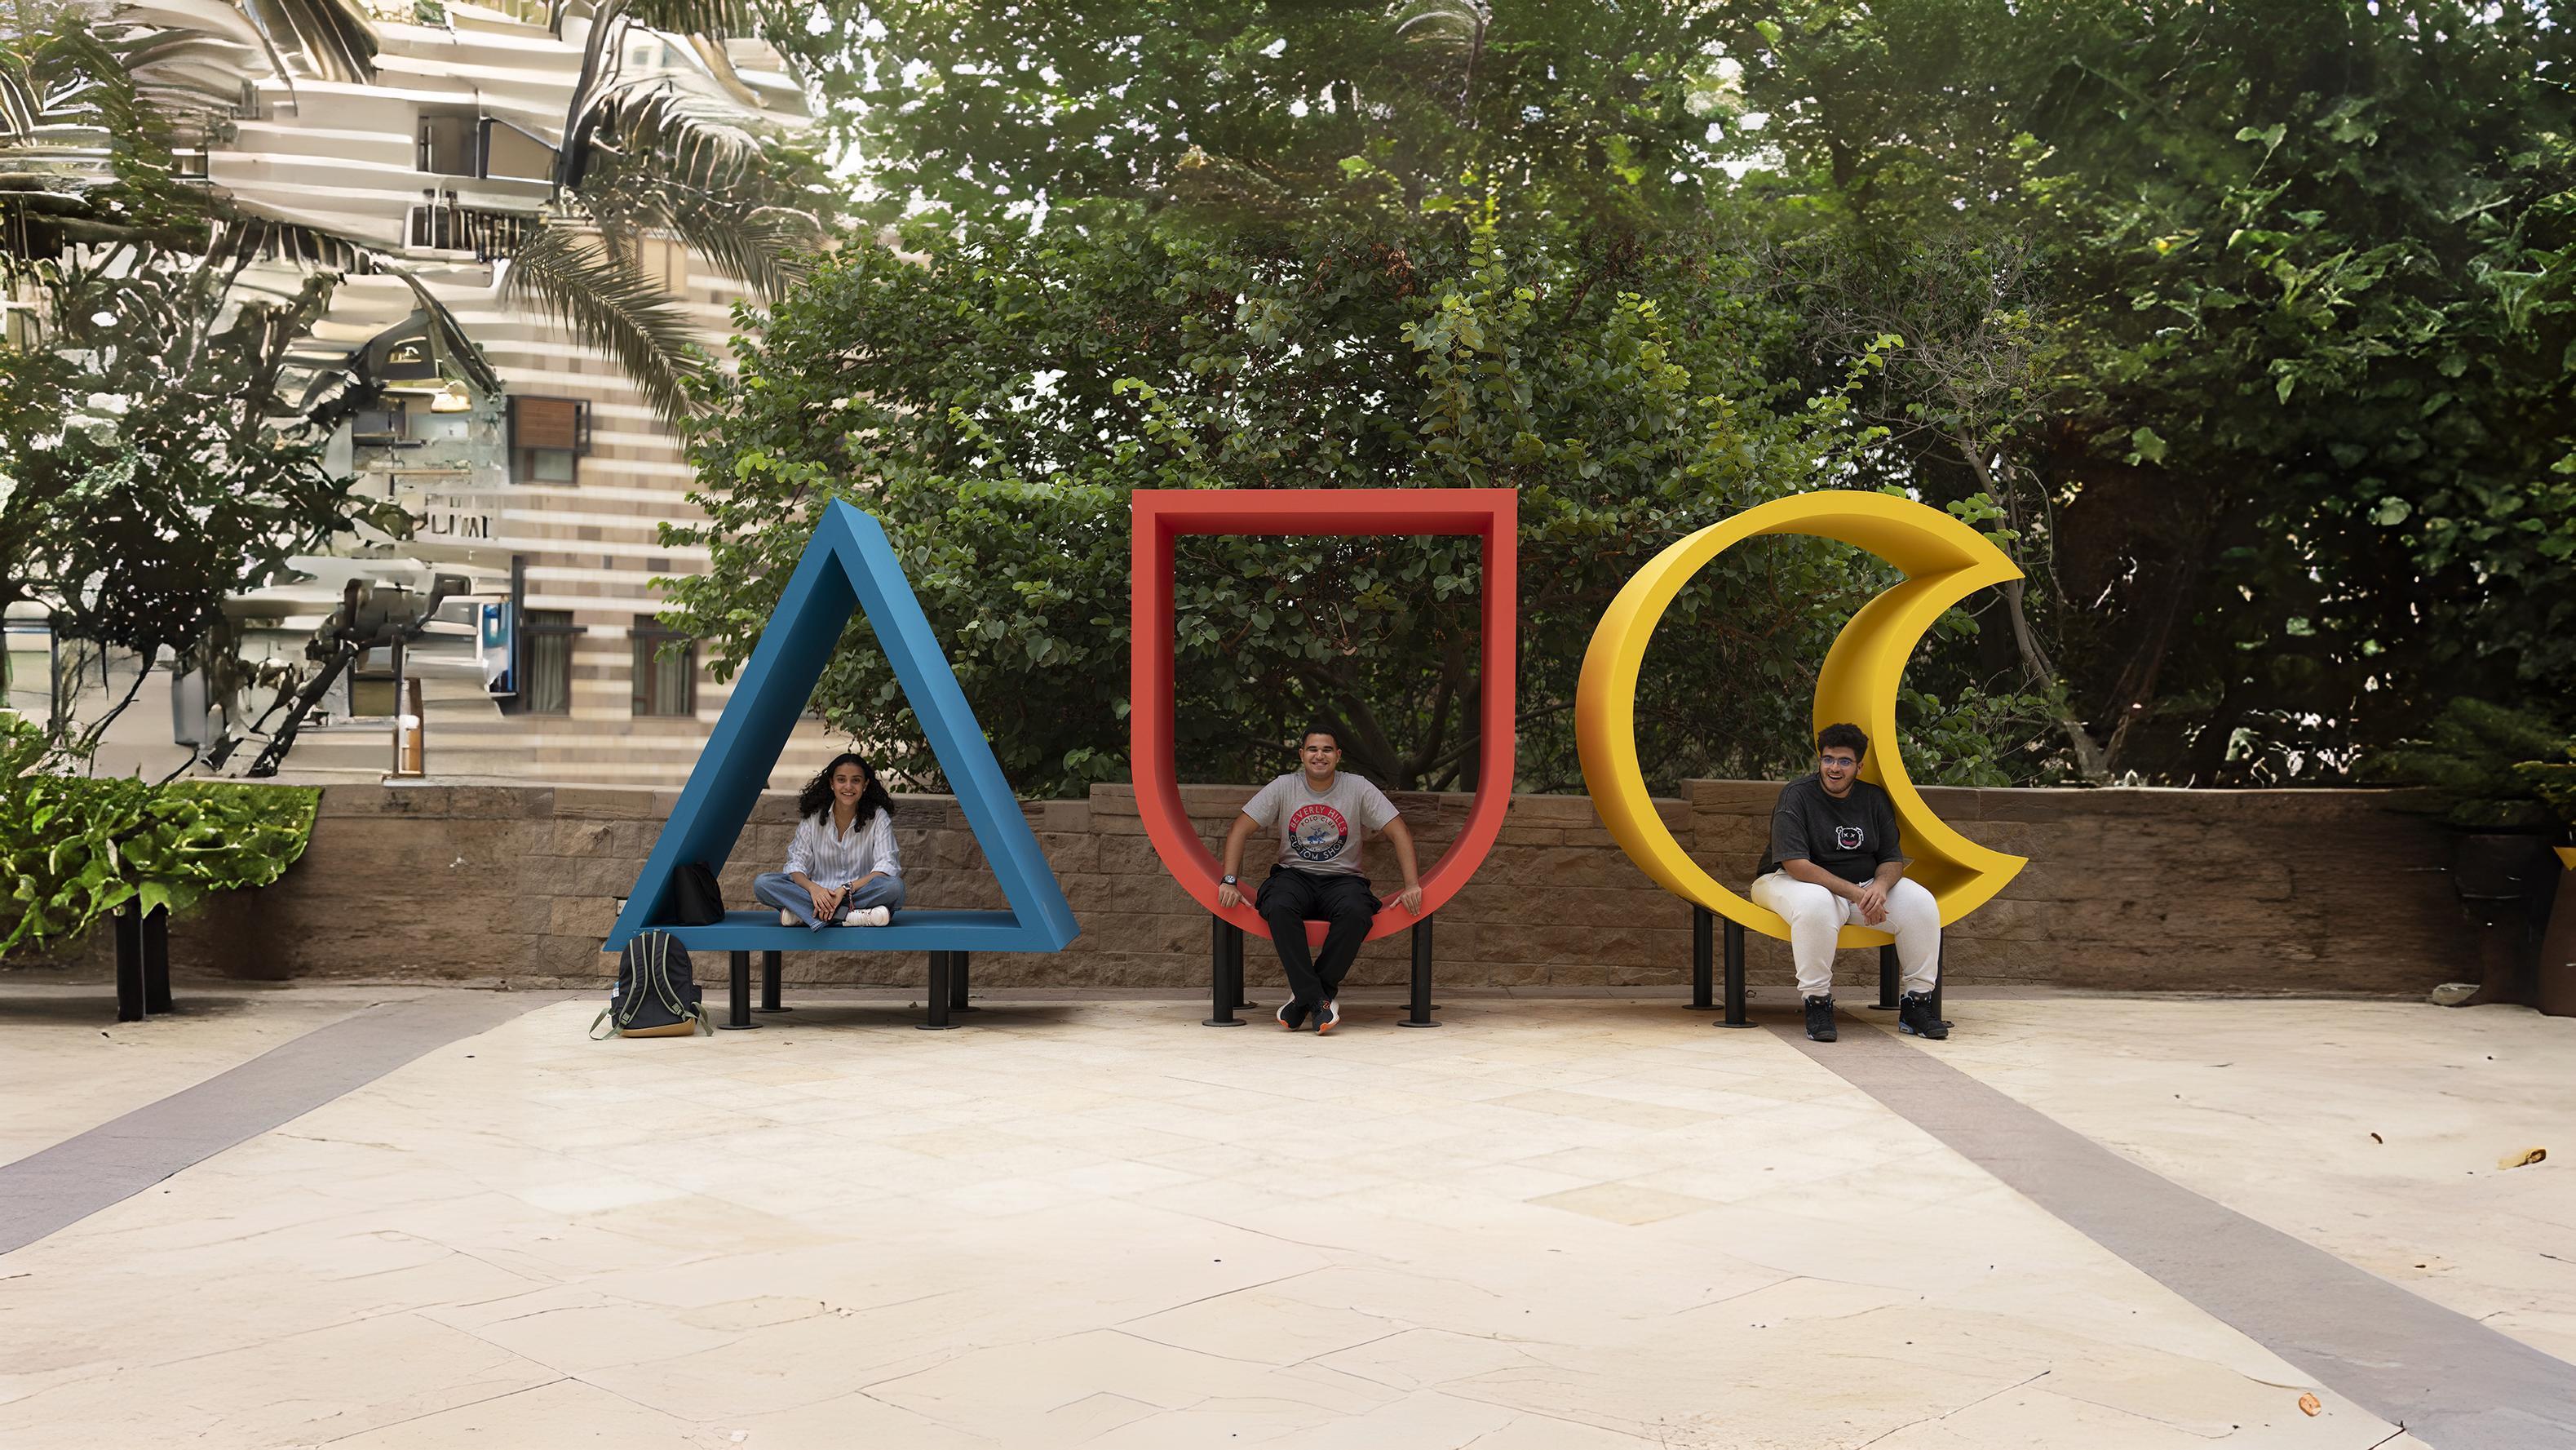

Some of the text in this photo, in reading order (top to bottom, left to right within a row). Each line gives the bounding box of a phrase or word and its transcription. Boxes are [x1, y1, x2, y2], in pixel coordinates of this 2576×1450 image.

[1290, 806, 1348, 832] BEVERLY HILLS
[1300, 816, 1336, 829] POLO CLUB
[1323, 839, 1344, 858] SHOP
